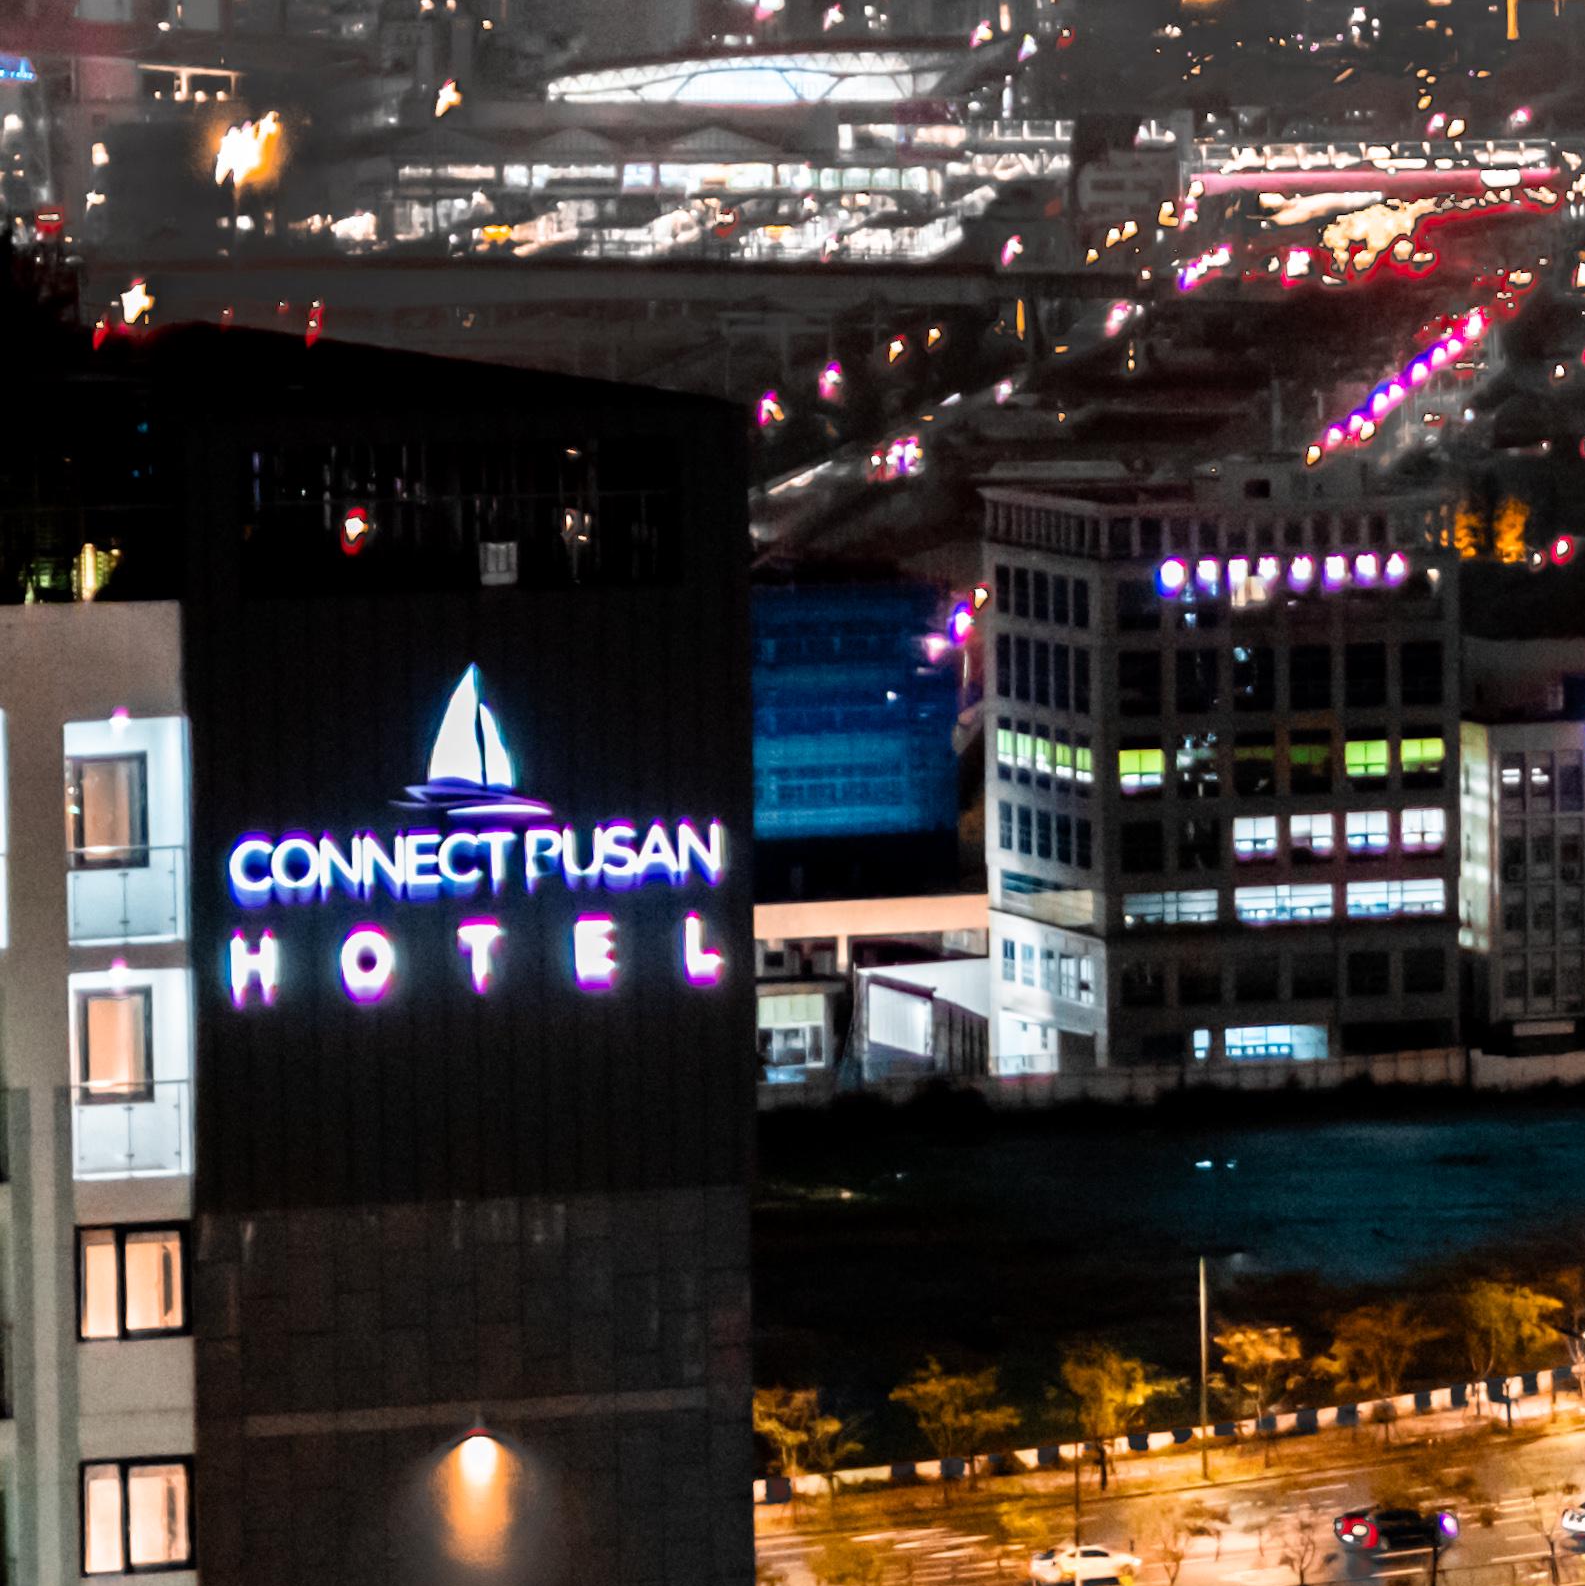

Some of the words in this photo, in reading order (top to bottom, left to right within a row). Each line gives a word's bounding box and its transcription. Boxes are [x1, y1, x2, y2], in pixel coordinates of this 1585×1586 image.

[228, 825, 515, 904] CONNECT
[525, 819, 724, 894] PUSAN
[228, 912, 723, 1007] HOTEL
